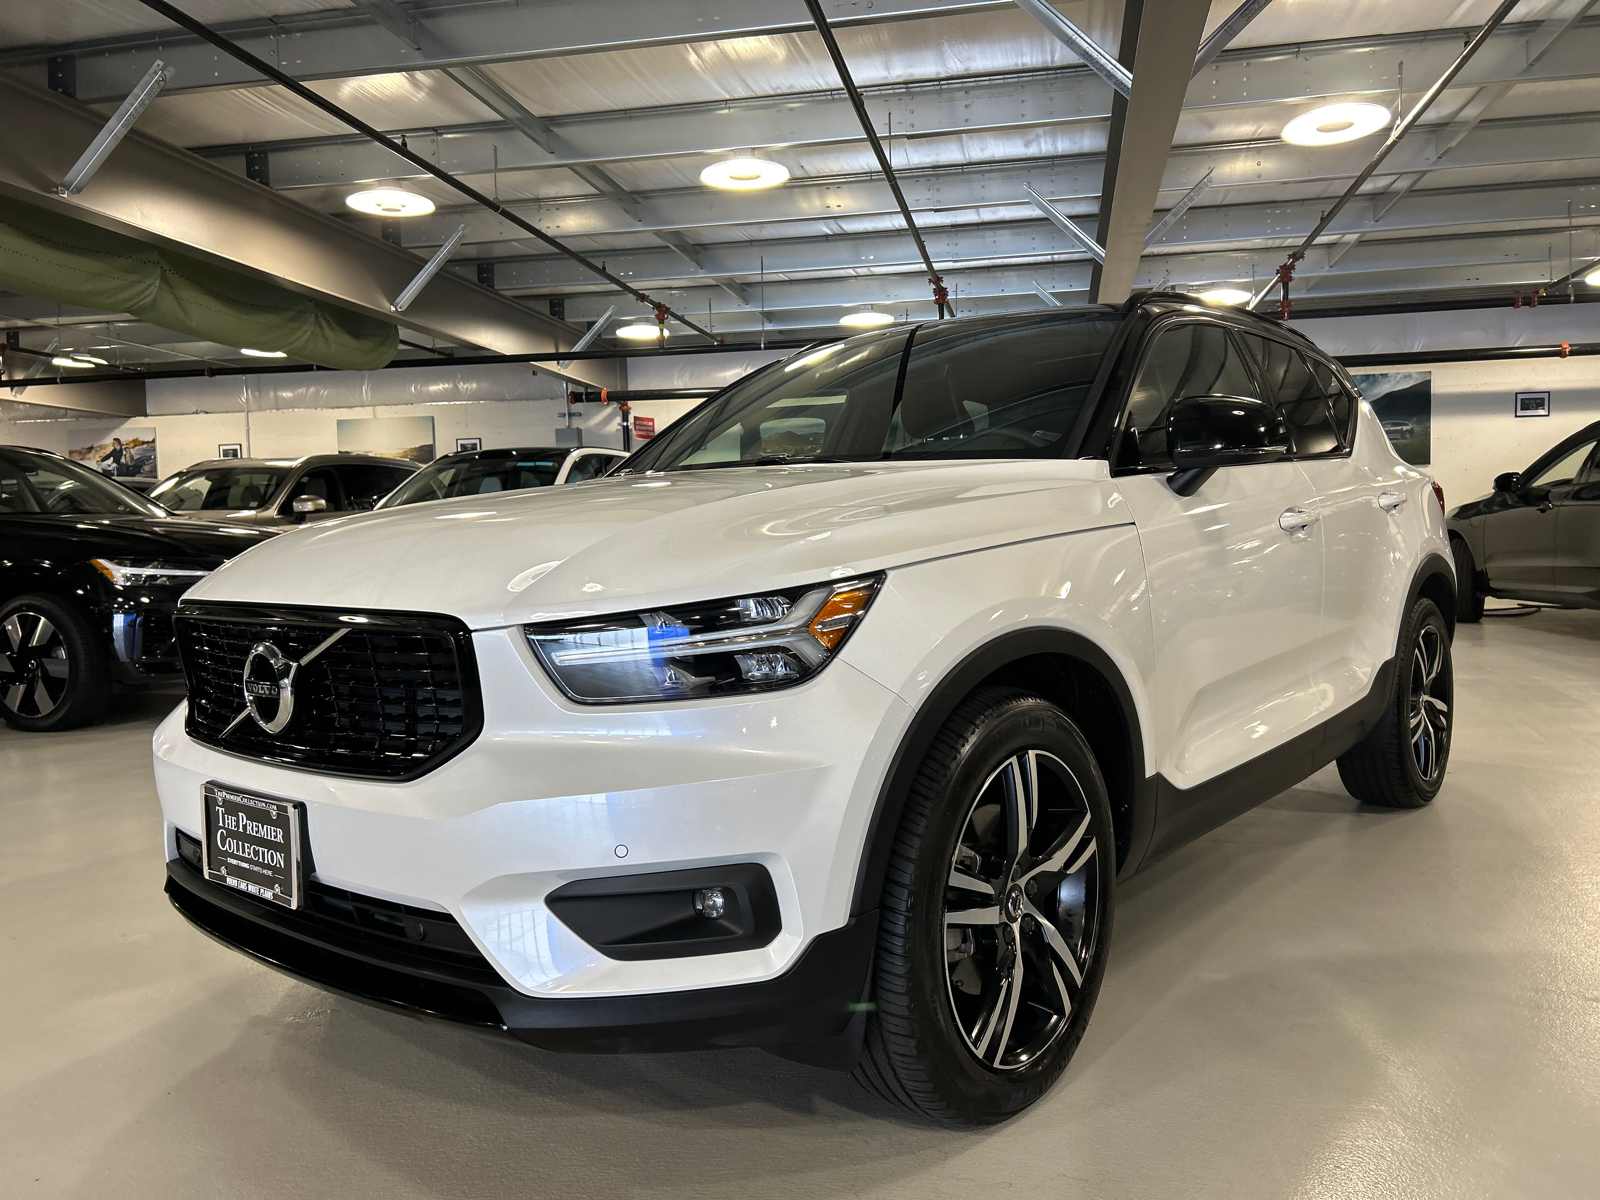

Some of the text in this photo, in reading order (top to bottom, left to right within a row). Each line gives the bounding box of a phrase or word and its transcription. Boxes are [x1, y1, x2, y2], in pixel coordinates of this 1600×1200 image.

[247, 683, 278, 695] VOLVO
[237, 812, 285, 844] PREMIER
[216, 829, 285, 869] COLLECTION
